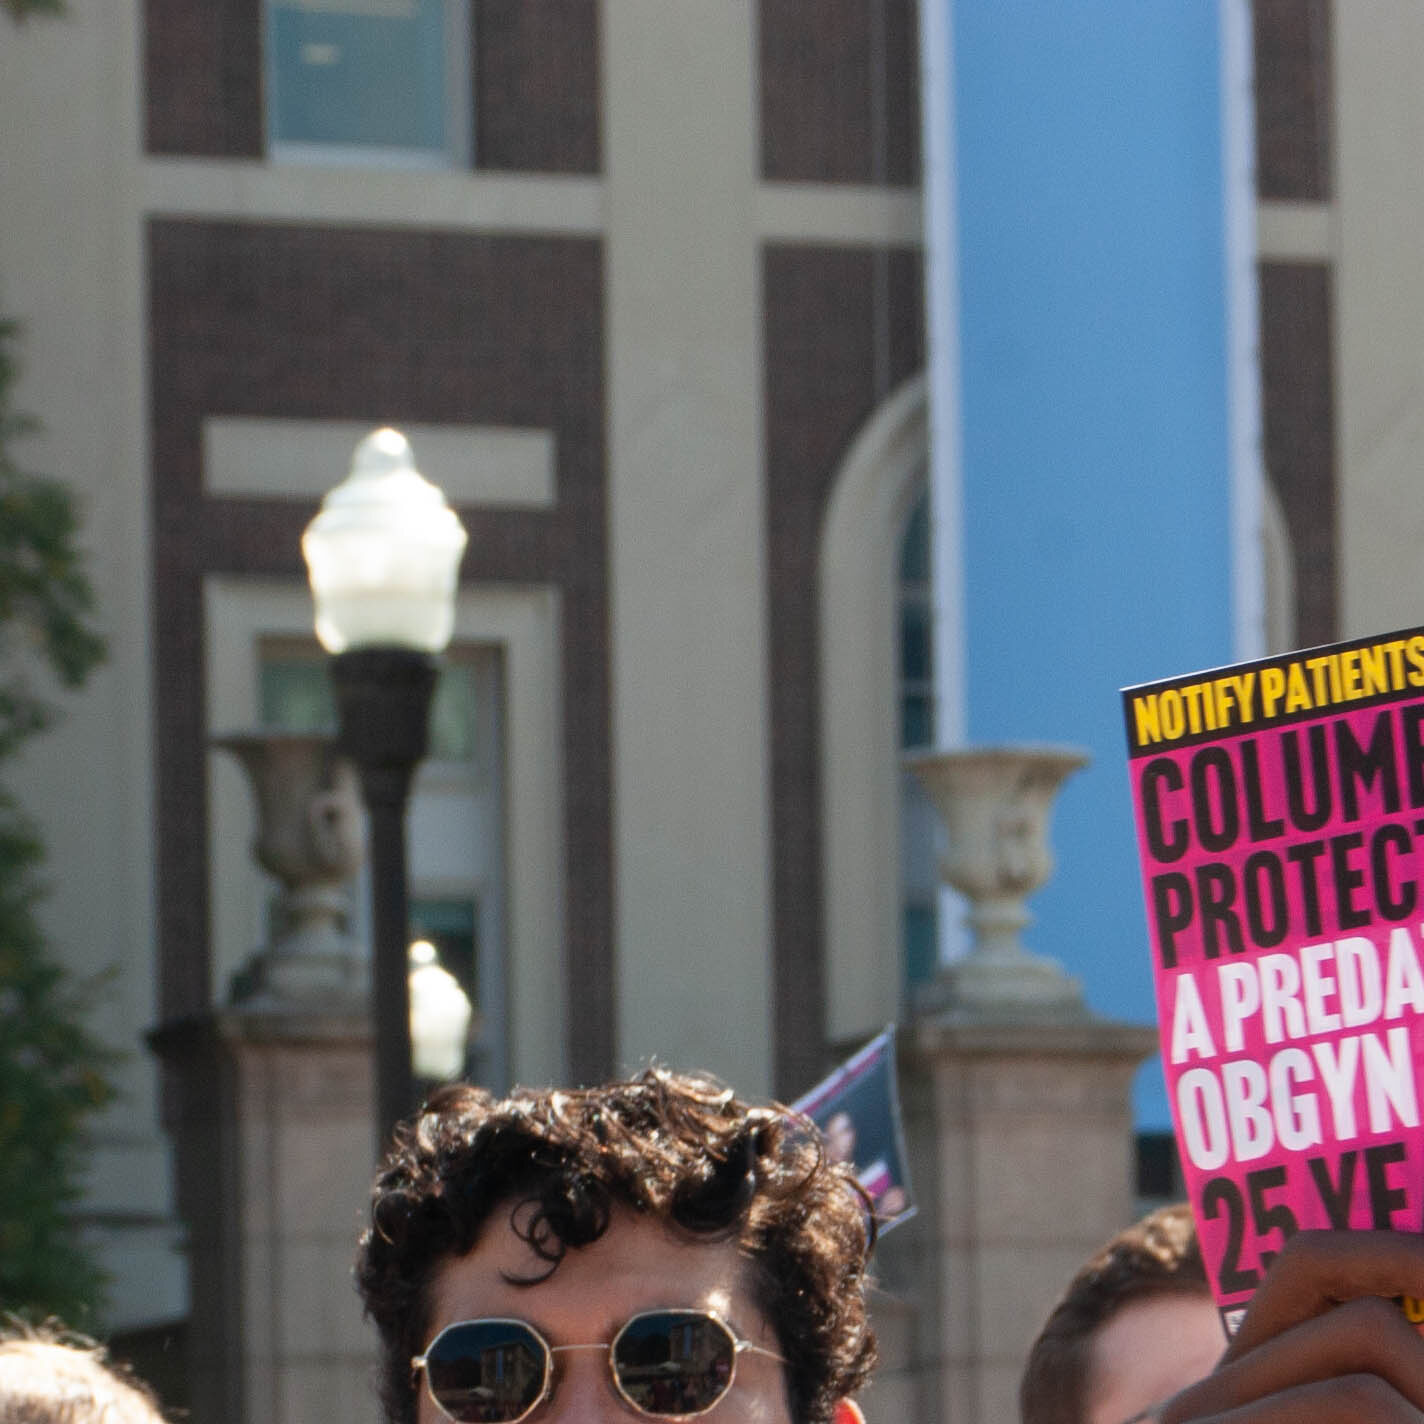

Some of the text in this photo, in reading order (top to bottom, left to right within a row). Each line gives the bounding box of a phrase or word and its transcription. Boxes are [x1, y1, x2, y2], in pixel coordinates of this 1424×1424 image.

[1133, 670, 1256, 747] NOTIFY
[1170, 971, 1215, 1066] A
[1176, 1026, 1420, 1172] OBGYN
[1201, 1166, 1297, 1295] 25
